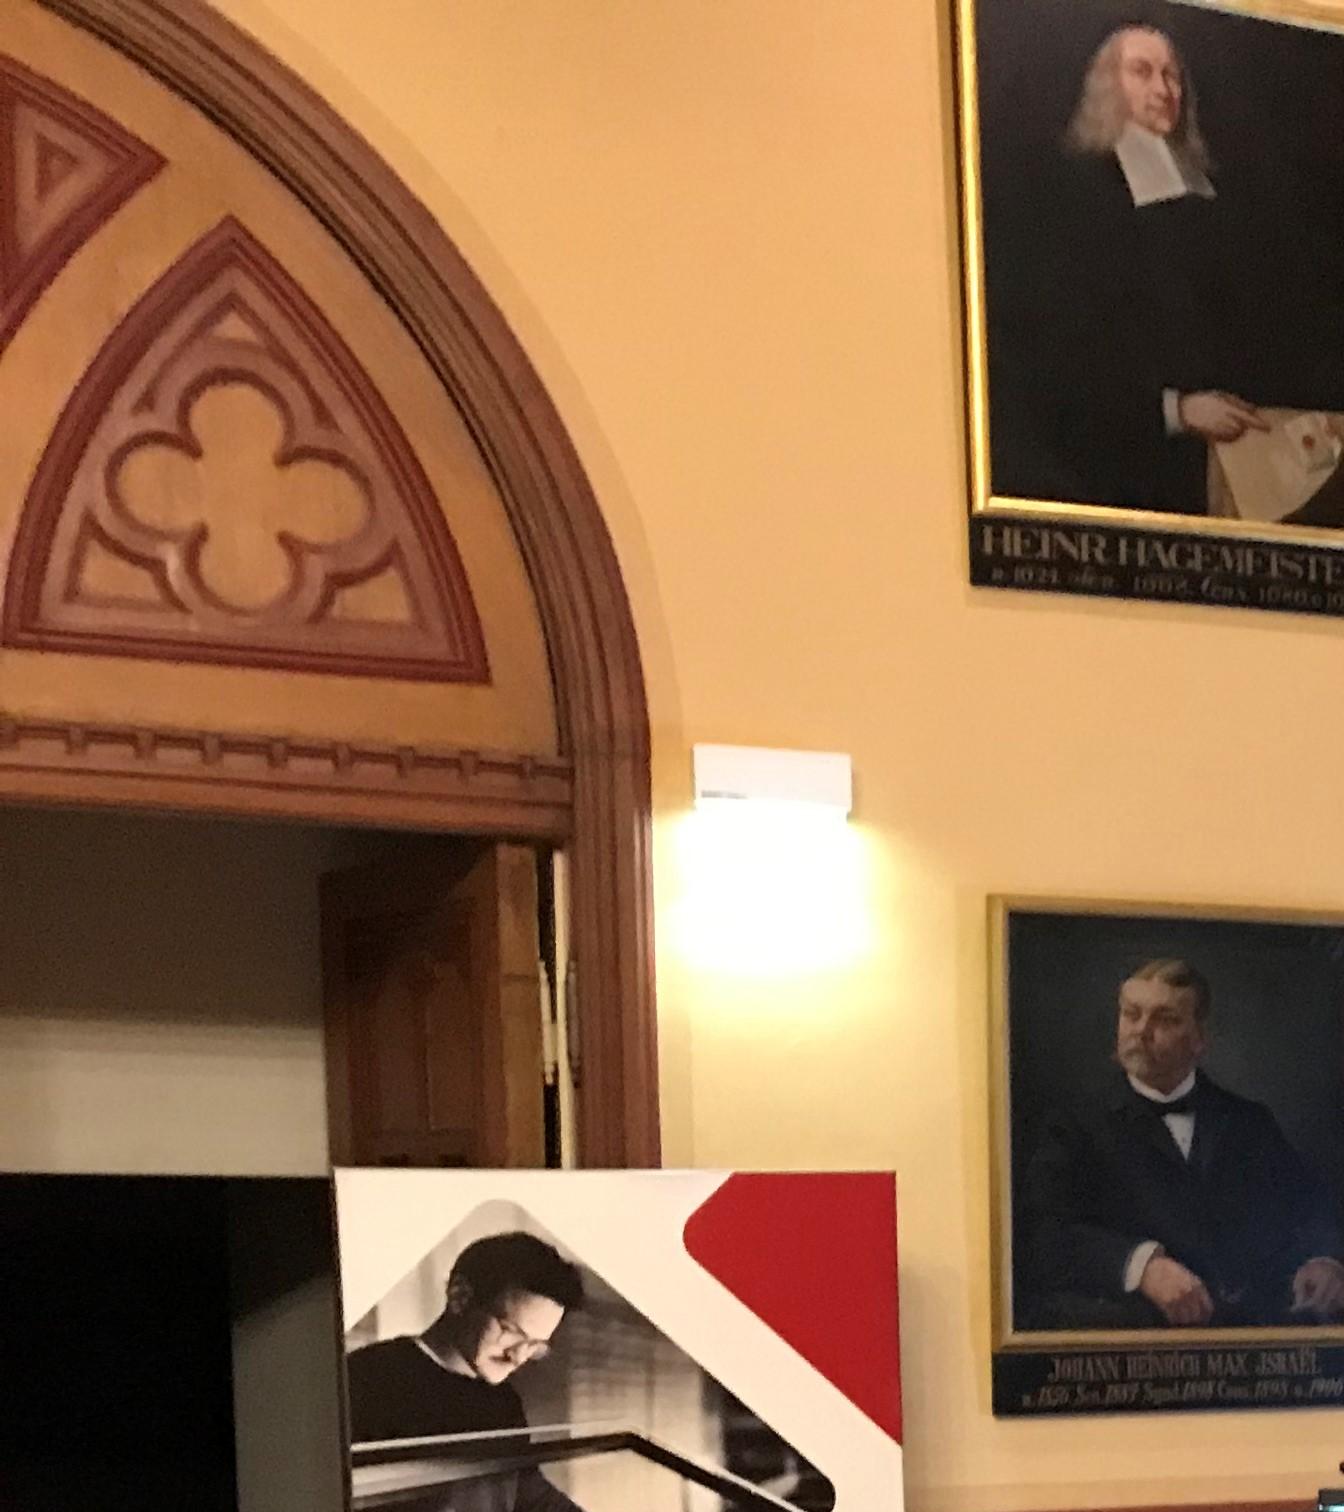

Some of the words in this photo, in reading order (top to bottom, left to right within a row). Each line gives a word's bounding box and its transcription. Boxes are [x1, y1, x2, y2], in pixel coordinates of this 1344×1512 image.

[1048, 1356, 1120, 1381] JOHANN
[1127, 1351, 1200, 1378] HEINRICH
[1207, 1354, 1247, 1376] MAX
